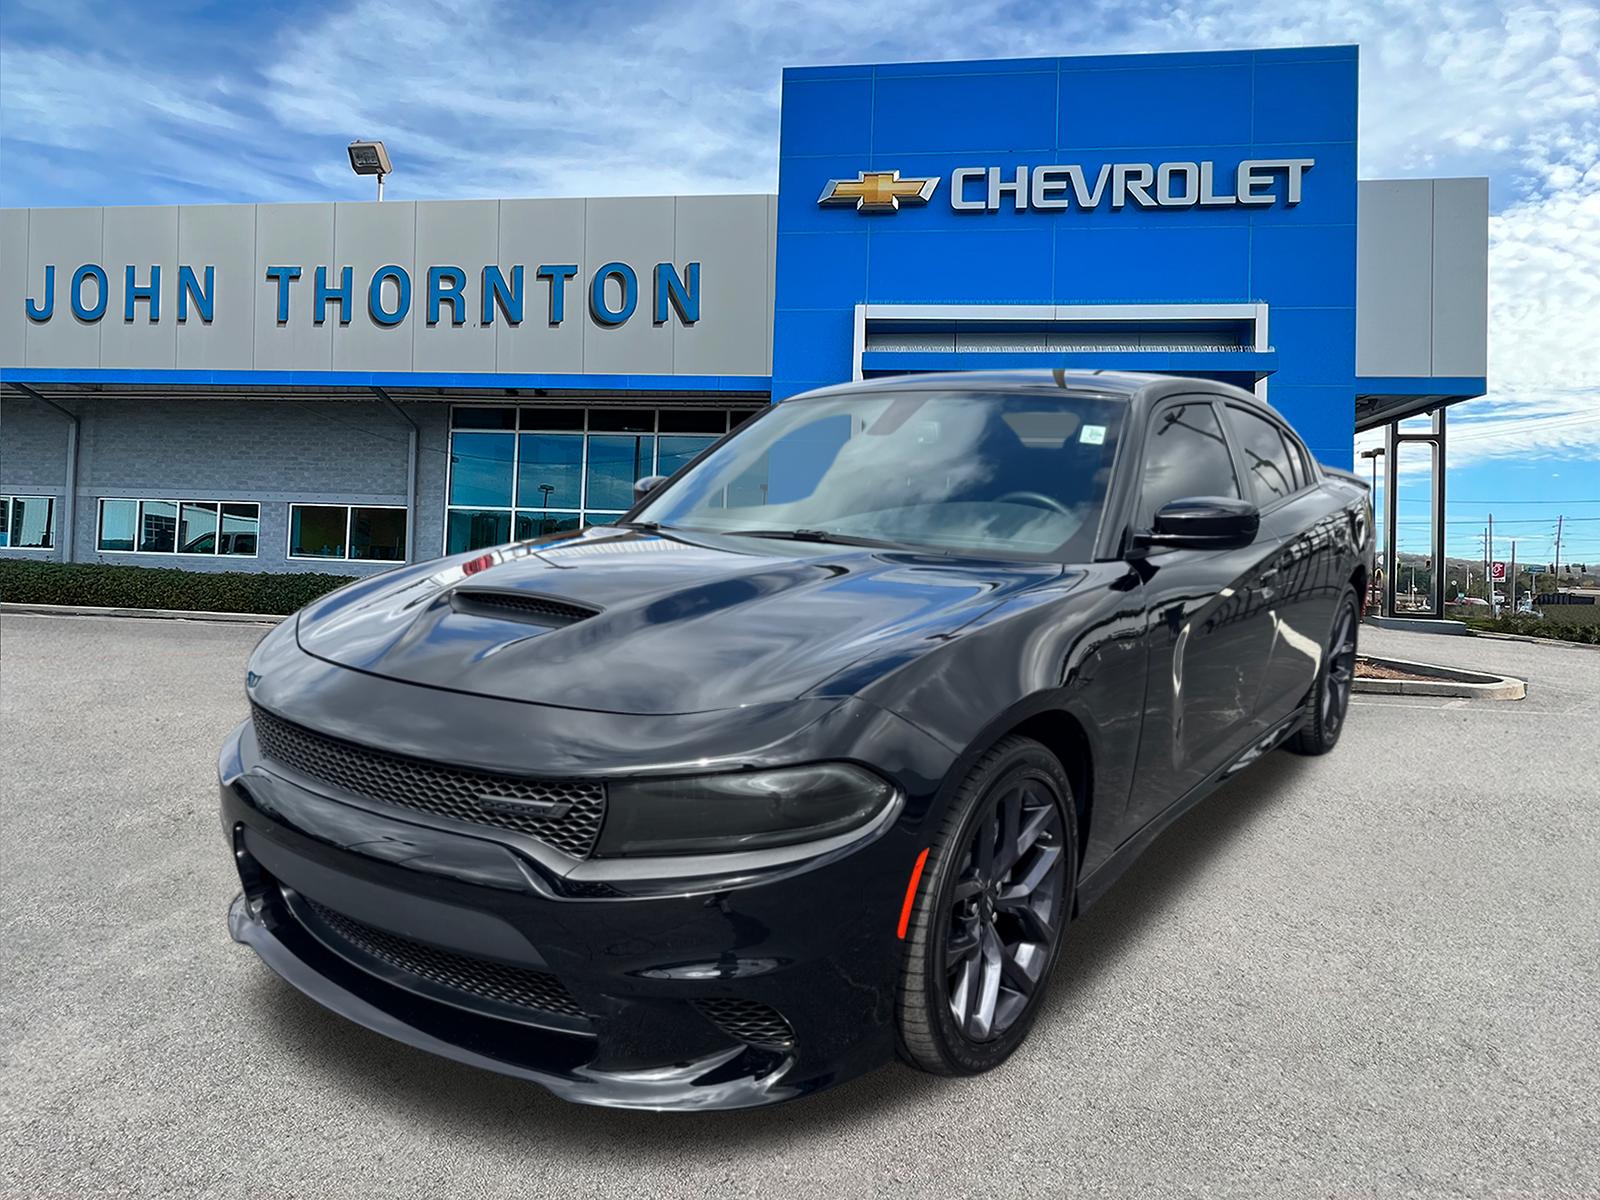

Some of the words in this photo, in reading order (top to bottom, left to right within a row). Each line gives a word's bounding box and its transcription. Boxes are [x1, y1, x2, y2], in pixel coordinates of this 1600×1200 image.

[951, 158, 1315, 211] CHEVROLET
[26, 263, 216, 324] JOHN
[266, 262, 701, 327] THORNTON
